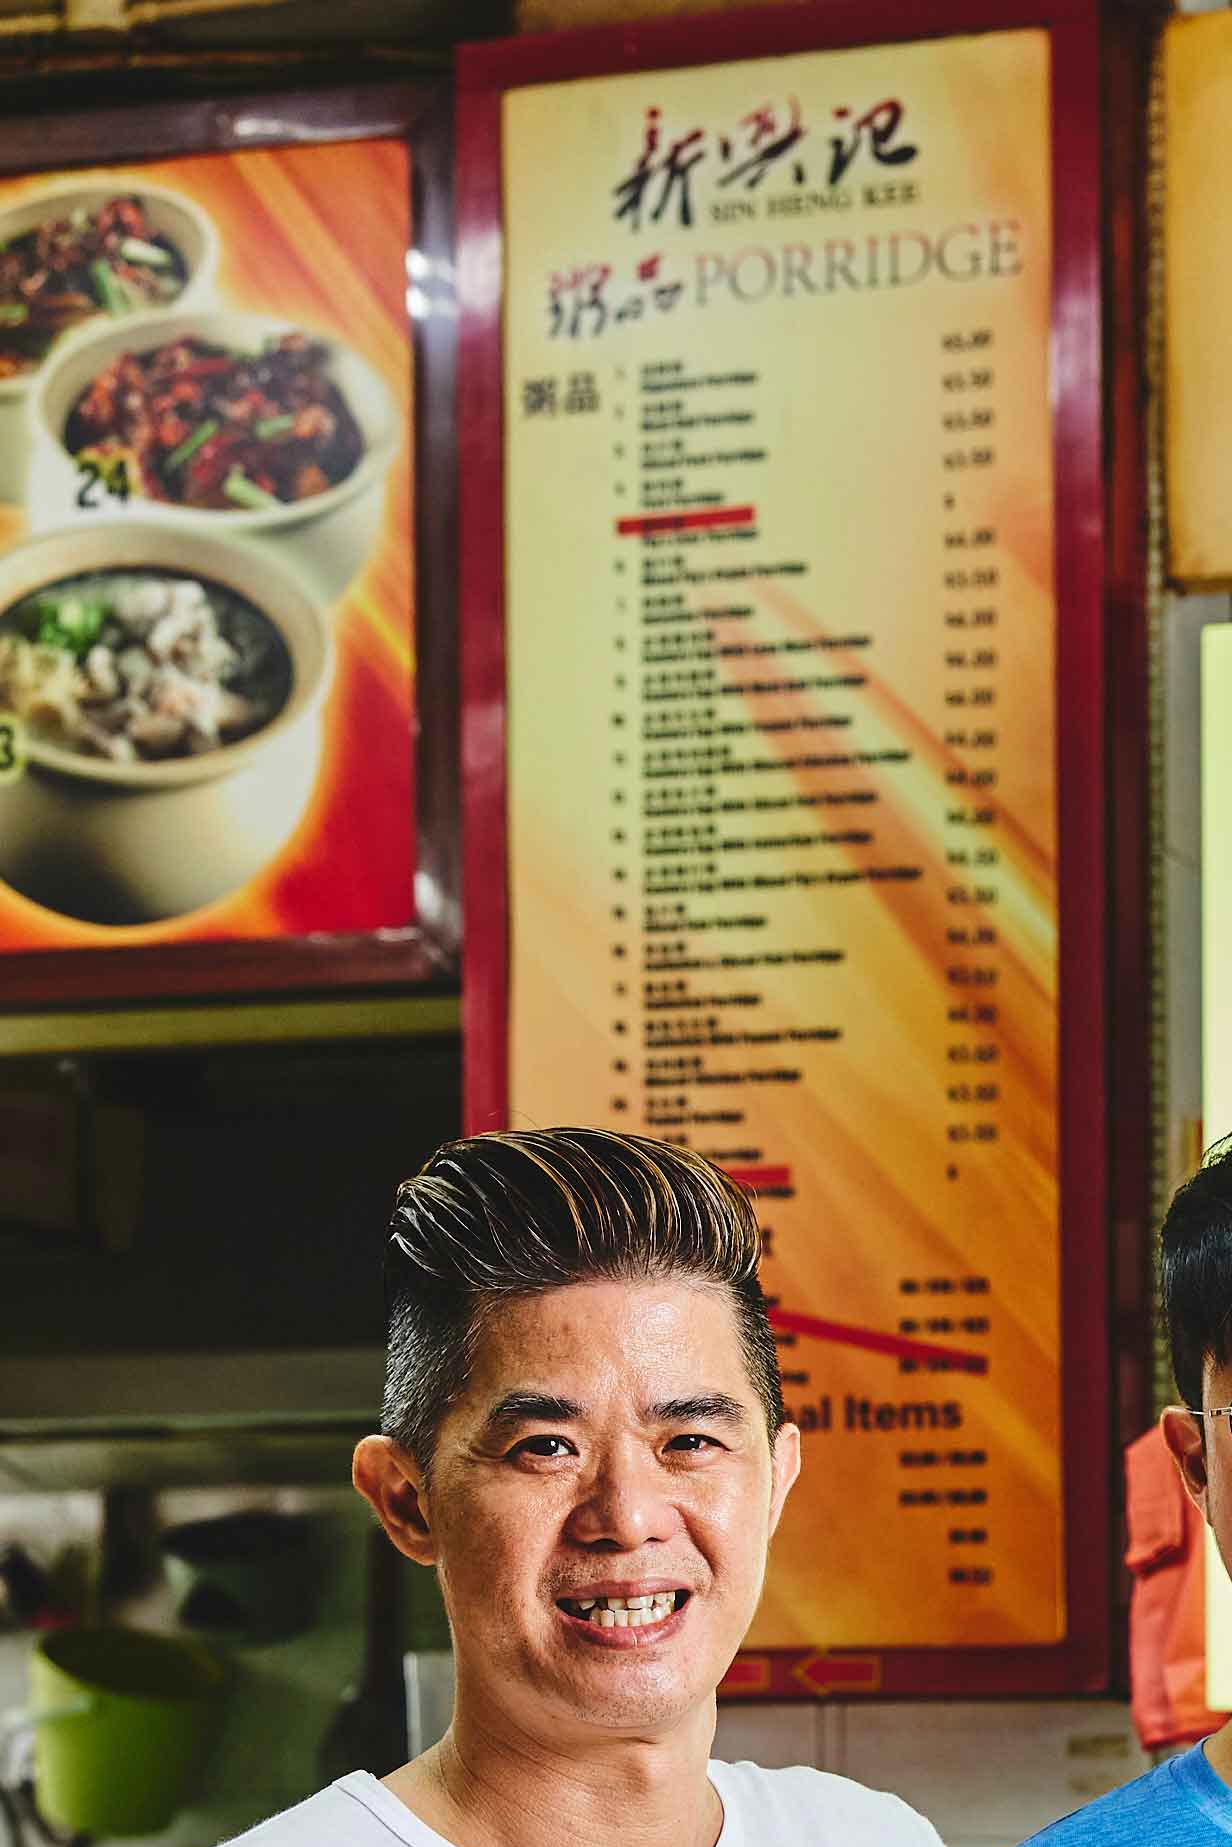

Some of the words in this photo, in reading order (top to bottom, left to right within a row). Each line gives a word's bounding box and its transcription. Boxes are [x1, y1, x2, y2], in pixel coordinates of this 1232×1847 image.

[694, 220, 1024, 304] PORRIDGE
[76, 458, 130, 508] 24
[844, 1396, 962, 1431] Items
